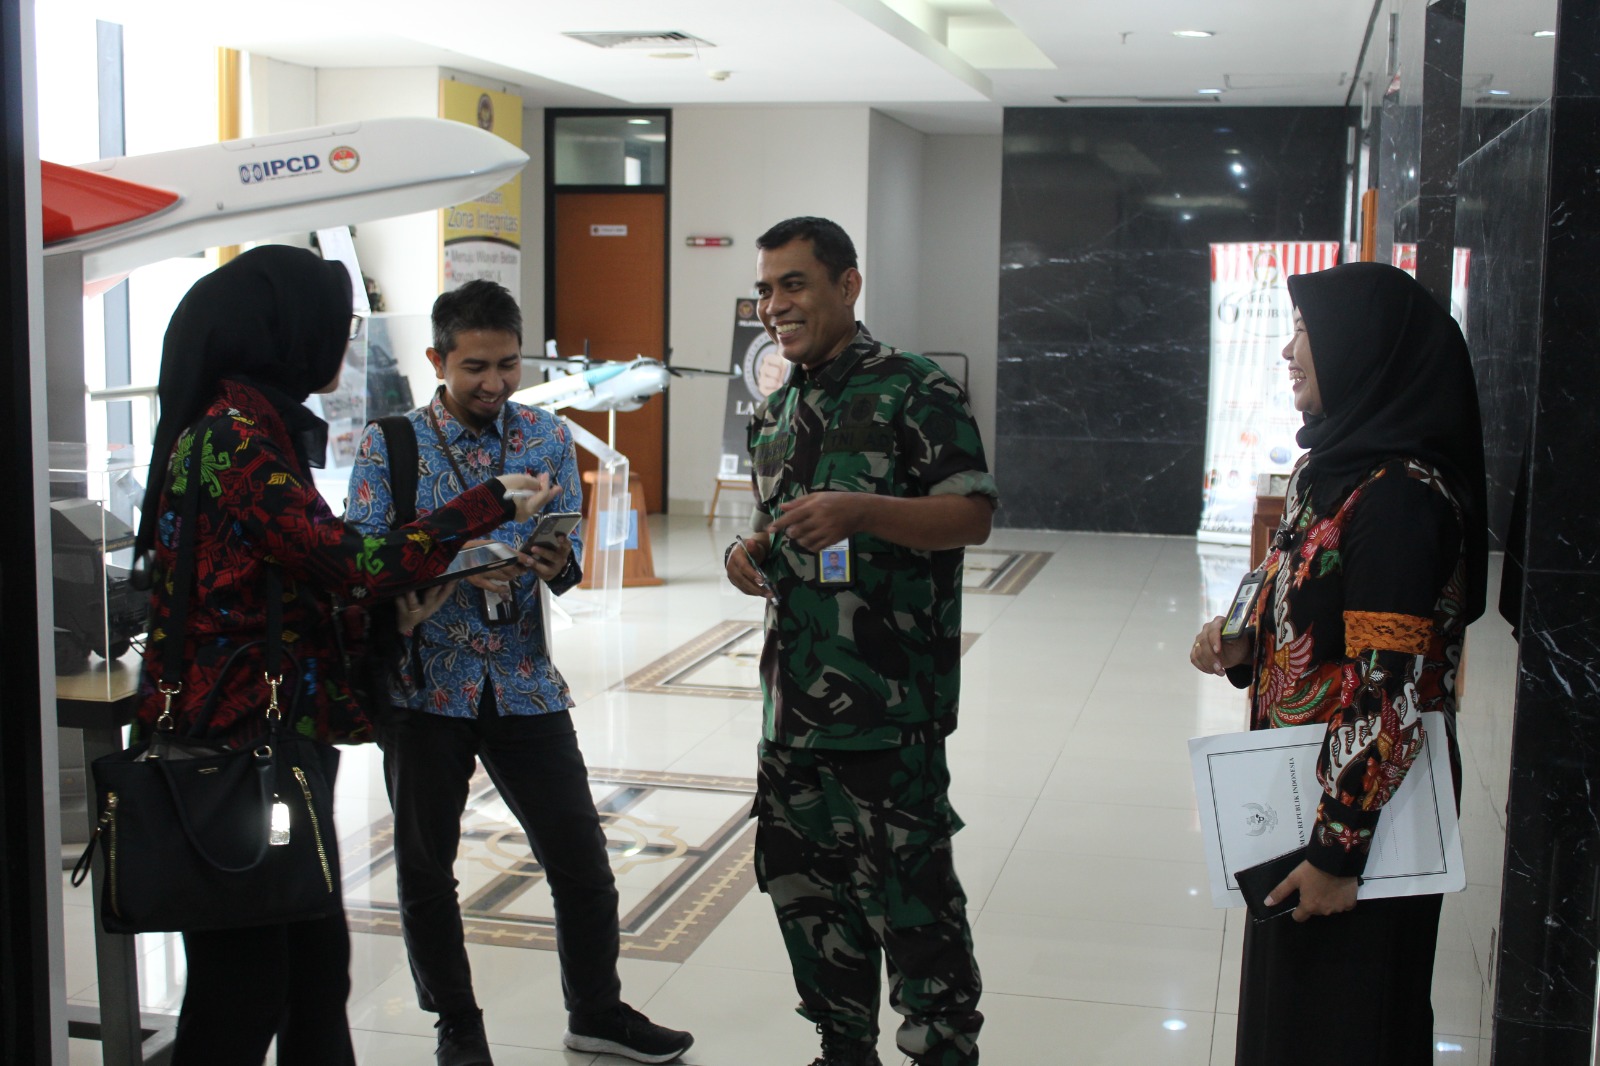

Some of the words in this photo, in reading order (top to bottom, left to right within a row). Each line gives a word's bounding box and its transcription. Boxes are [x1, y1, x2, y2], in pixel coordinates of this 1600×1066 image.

[262, 155, 321, 176] IPCD
[448, 206, 474, 229] Zona
[1289, 757, 1299, 794] INDONESIA
[1294, 795, 1304, 829] REPUBLIK
